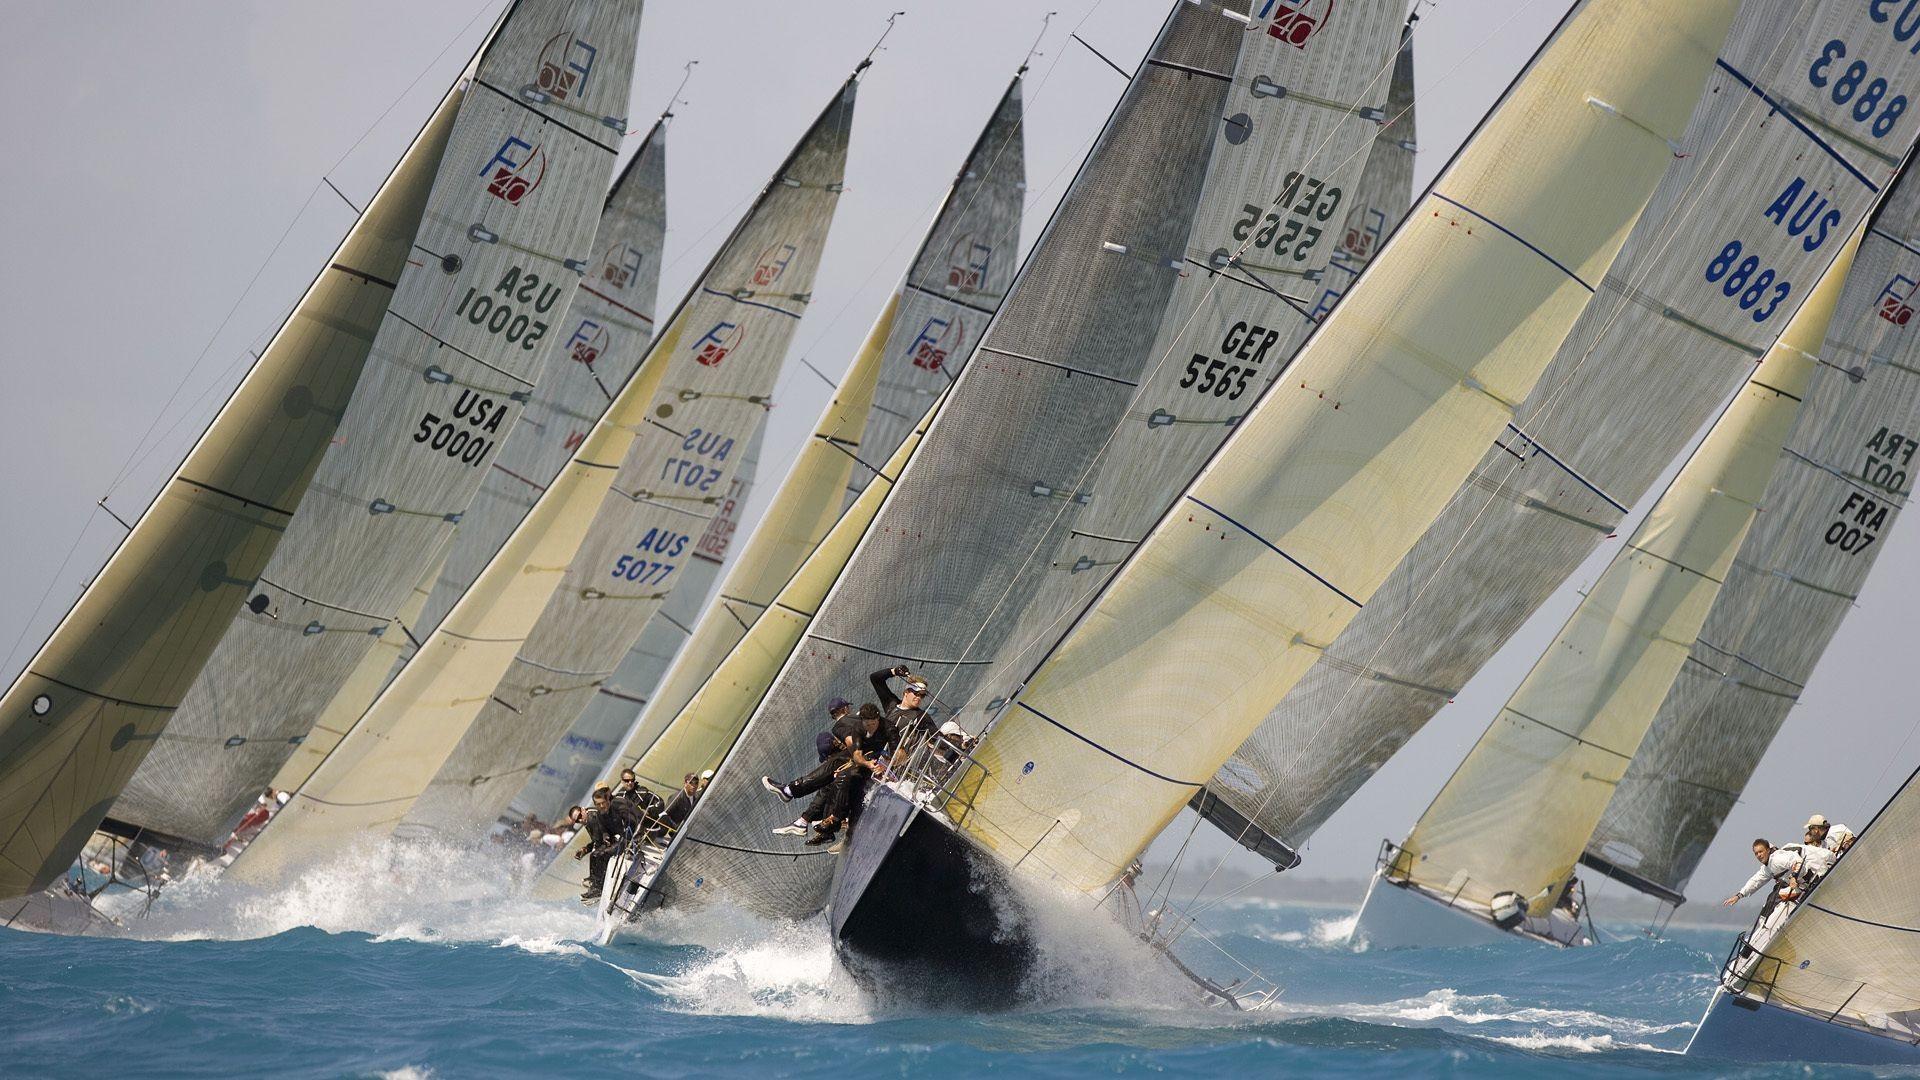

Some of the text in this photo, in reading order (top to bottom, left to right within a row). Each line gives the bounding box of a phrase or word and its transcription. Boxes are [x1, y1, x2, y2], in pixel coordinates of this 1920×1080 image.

[1267, 4, 1317, 50] 40
[479, 136, 532, 177] F
[487, 167, 530, 206] 40
[1764, 176, 1841, 252] AUS
[1705, 240, 1791, 322] 8883
[1873, 273, 1916, 307] F
[693, 322, 735, 350] F
[907, 317, 948, 355] F
[1221, 321, 1279, 364] GER
[1180, 353, 1257, 401] 5565
[453, 389, 508, 434] USA
[413, 412, 494, 467] 50001
[1839, 492, 1889, 532] FRA
[637, 528, 690, 557] AUS
[1825, 520, 1875, 556] 007
[612, 555, 674, 585] 5077
